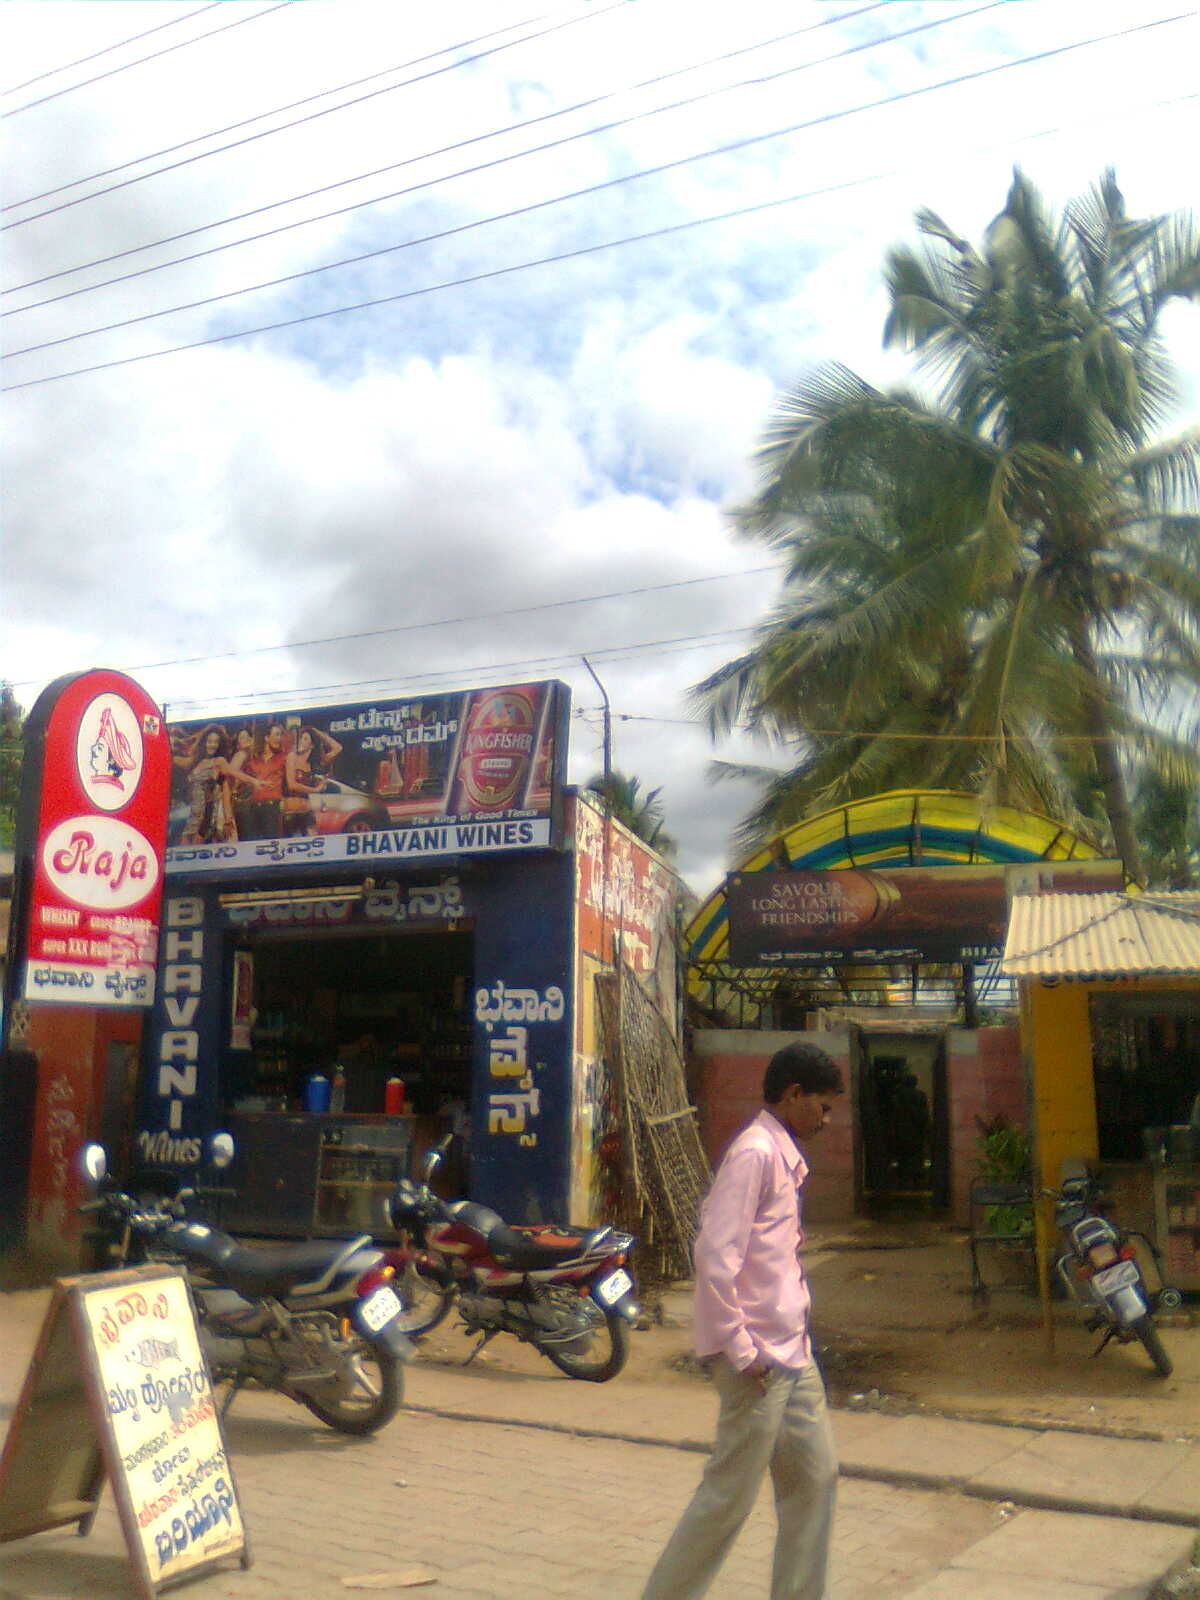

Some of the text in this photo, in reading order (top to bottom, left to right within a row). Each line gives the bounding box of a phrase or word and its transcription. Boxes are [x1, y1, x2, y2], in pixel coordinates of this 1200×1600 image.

[466, 732, 533, 752] KINGFISHER
[345, 821, 534, 857] BHAVANI WINES
[52, 830, 148, 892] Raja
[771, 881, 843, 898] SAVOUR
[751, 898, 796, 912] LONG
[761, 911, 860, 925] FRIENDSHIPS
[157, 897, 204, 1131] BHAVANI
[475, 980, 565, 1032] ಭವಾನಿ
